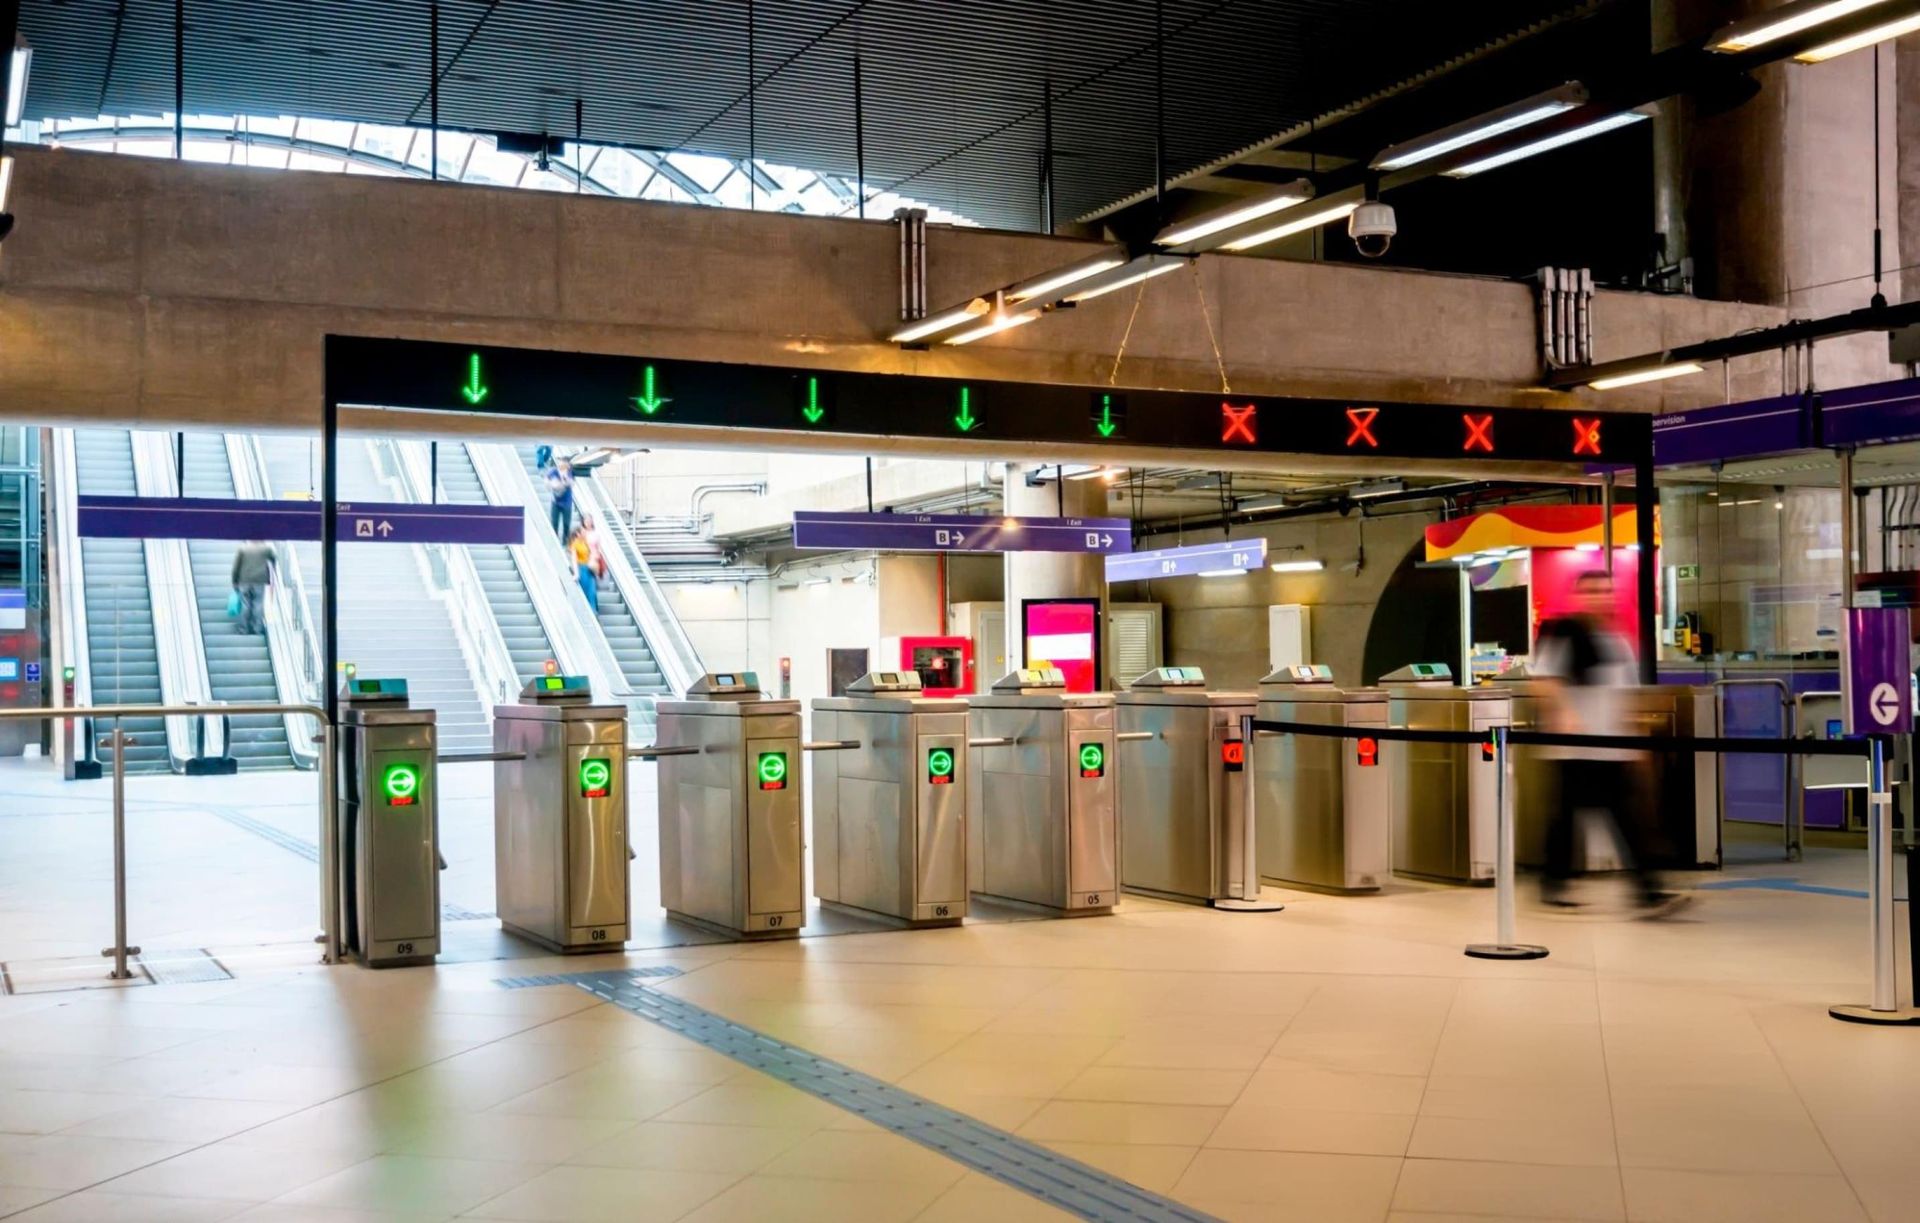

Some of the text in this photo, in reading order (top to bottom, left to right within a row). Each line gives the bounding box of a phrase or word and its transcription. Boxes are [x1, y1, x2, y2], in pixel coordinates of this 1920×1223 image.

[359, 522, 371, 534] A
[1088, 894, 1100, 905] 05
[936, 906, 948, 916] 06
[770, 916, 783, 927] 07
[592, 930, 606, 941] 08
[398, 943, 413, 954] 09
